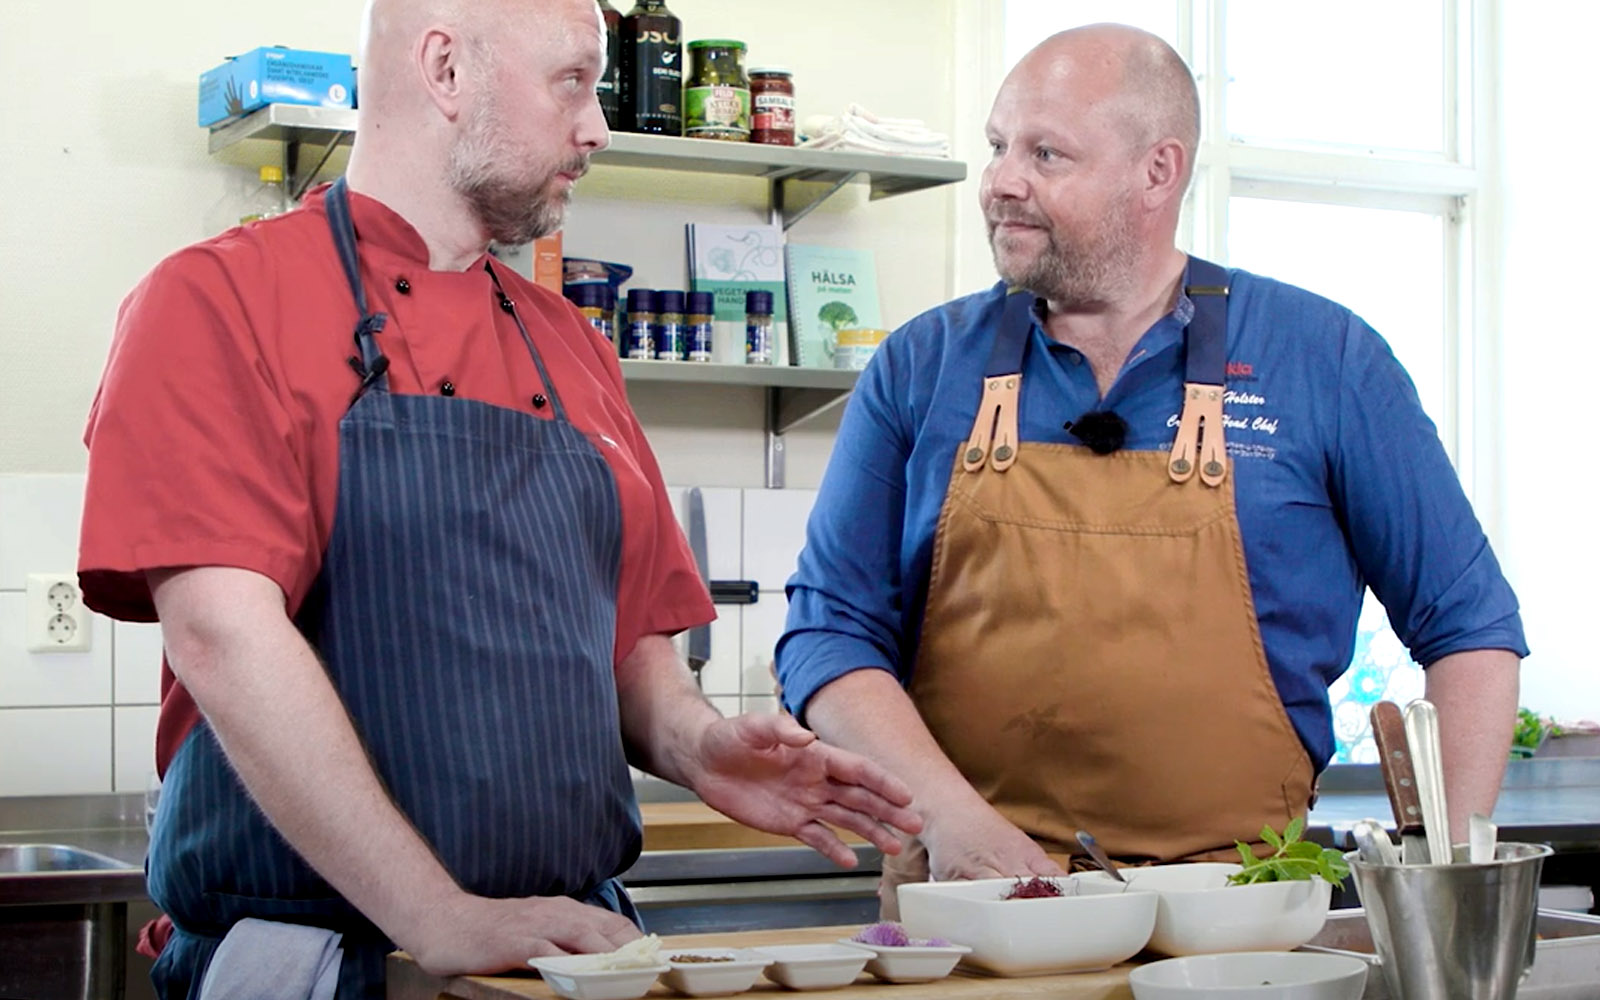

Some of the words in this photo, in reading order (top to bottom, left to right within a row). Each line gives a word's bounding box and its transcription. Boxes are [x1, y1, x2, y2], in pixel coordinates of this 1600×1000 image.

[758, 96, 789, 106] SAMBAL
[811, 270, 856, 286] HÄLSA
[1251, 416, 1279, 435] Chef
